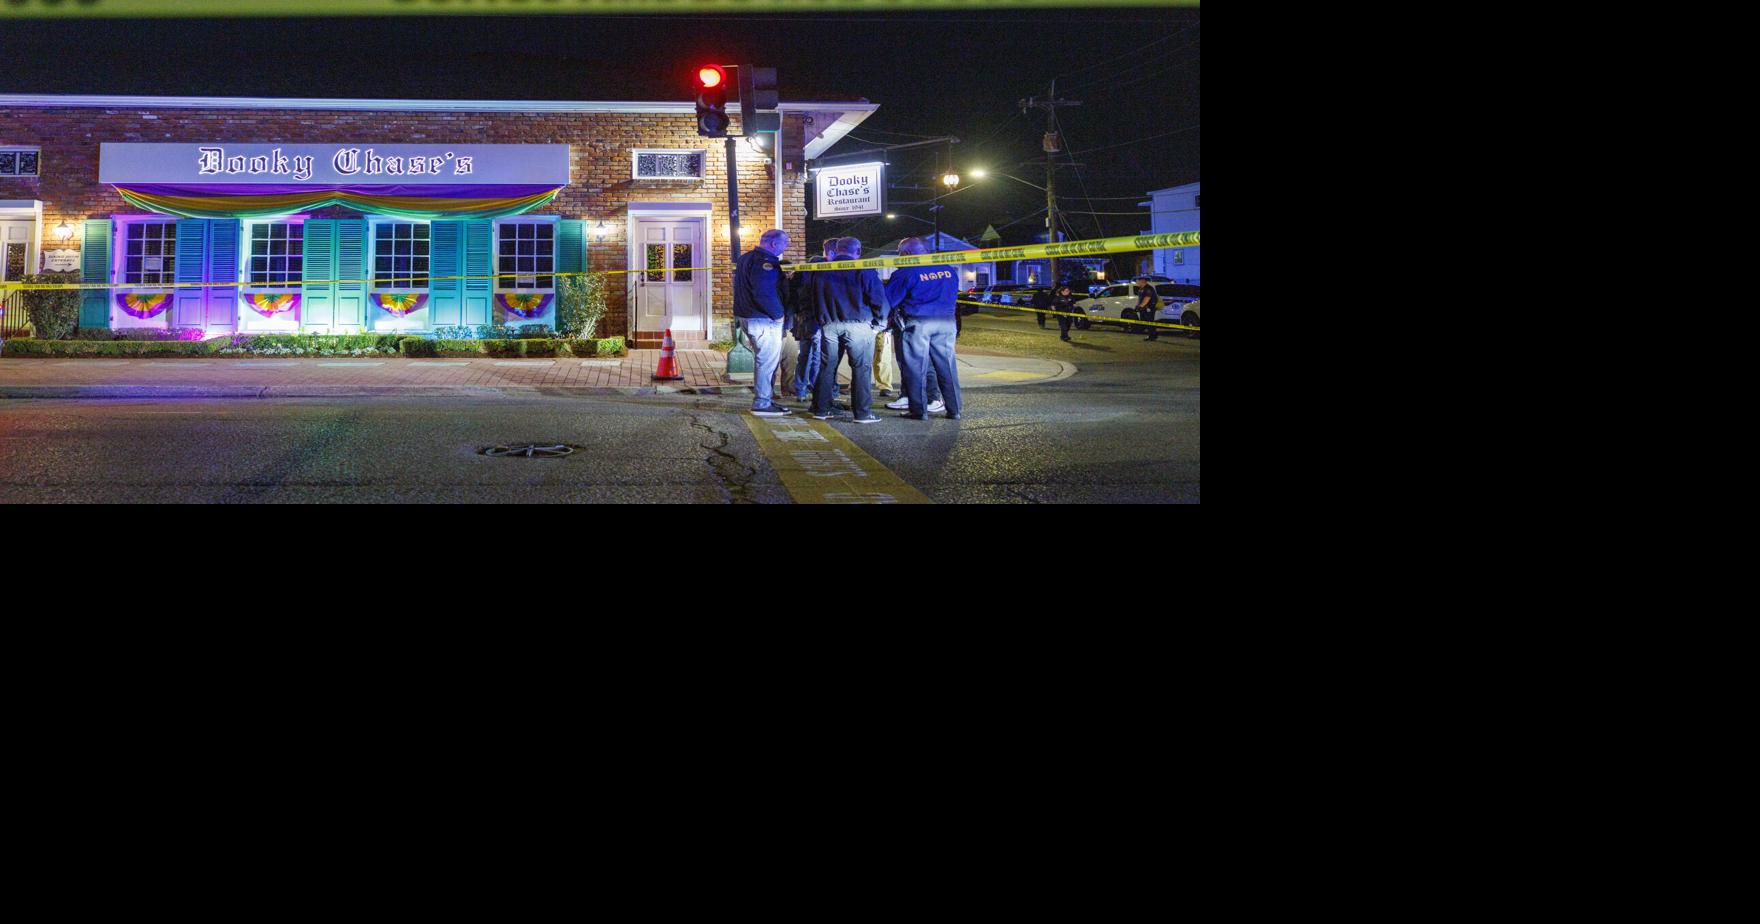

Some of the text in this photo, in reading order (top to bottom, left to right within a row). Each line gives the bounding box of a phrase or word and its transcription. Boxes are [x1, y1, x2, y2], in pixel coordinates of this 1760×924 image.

[199, 147, 473, 180] Dooky Chase's
[827, 175, 868, 187] Dooky
[826, 186, 870, 198] Chase's
[827, 196, 871, 206] Restaurant
[919, 270, 952, 282] NOPD
